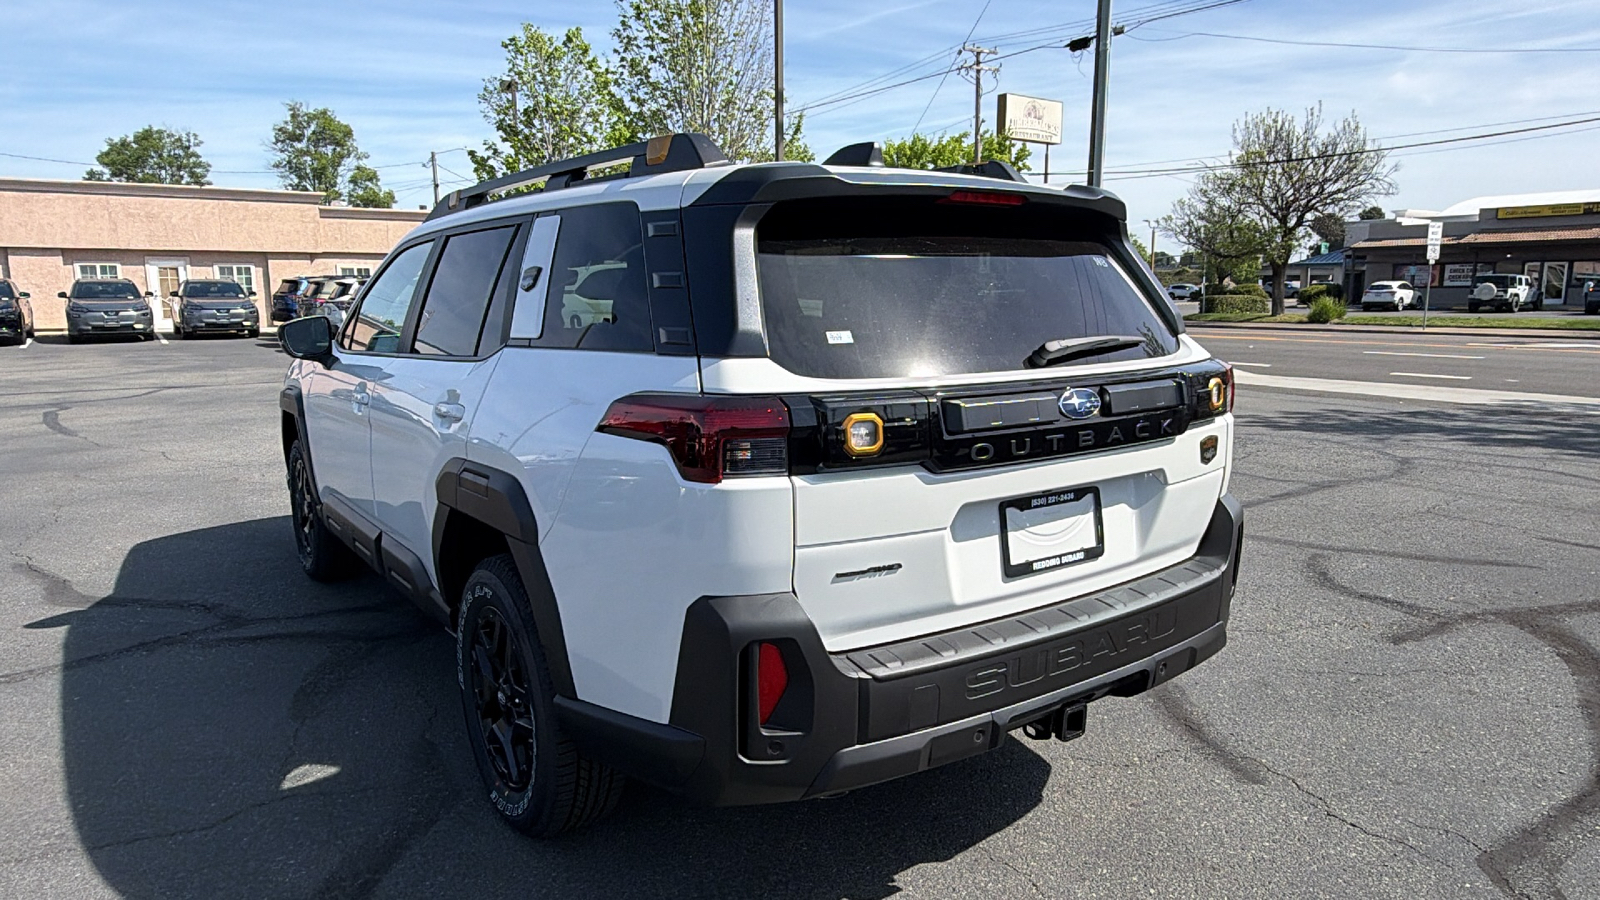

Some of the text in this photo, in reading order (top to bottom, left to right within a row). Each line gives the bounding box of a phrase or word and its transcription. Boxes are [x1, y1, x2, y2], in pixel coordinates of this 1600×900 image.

[971, 417, 1174, 462] OUTBACK
[1031, 497, 1047, 507] (530)
[1032, 551, 1085, 571] REDDING SUBARU
[474, 585, 493, 599] A/T
[964, 605, 1178, 701] SUBARU
